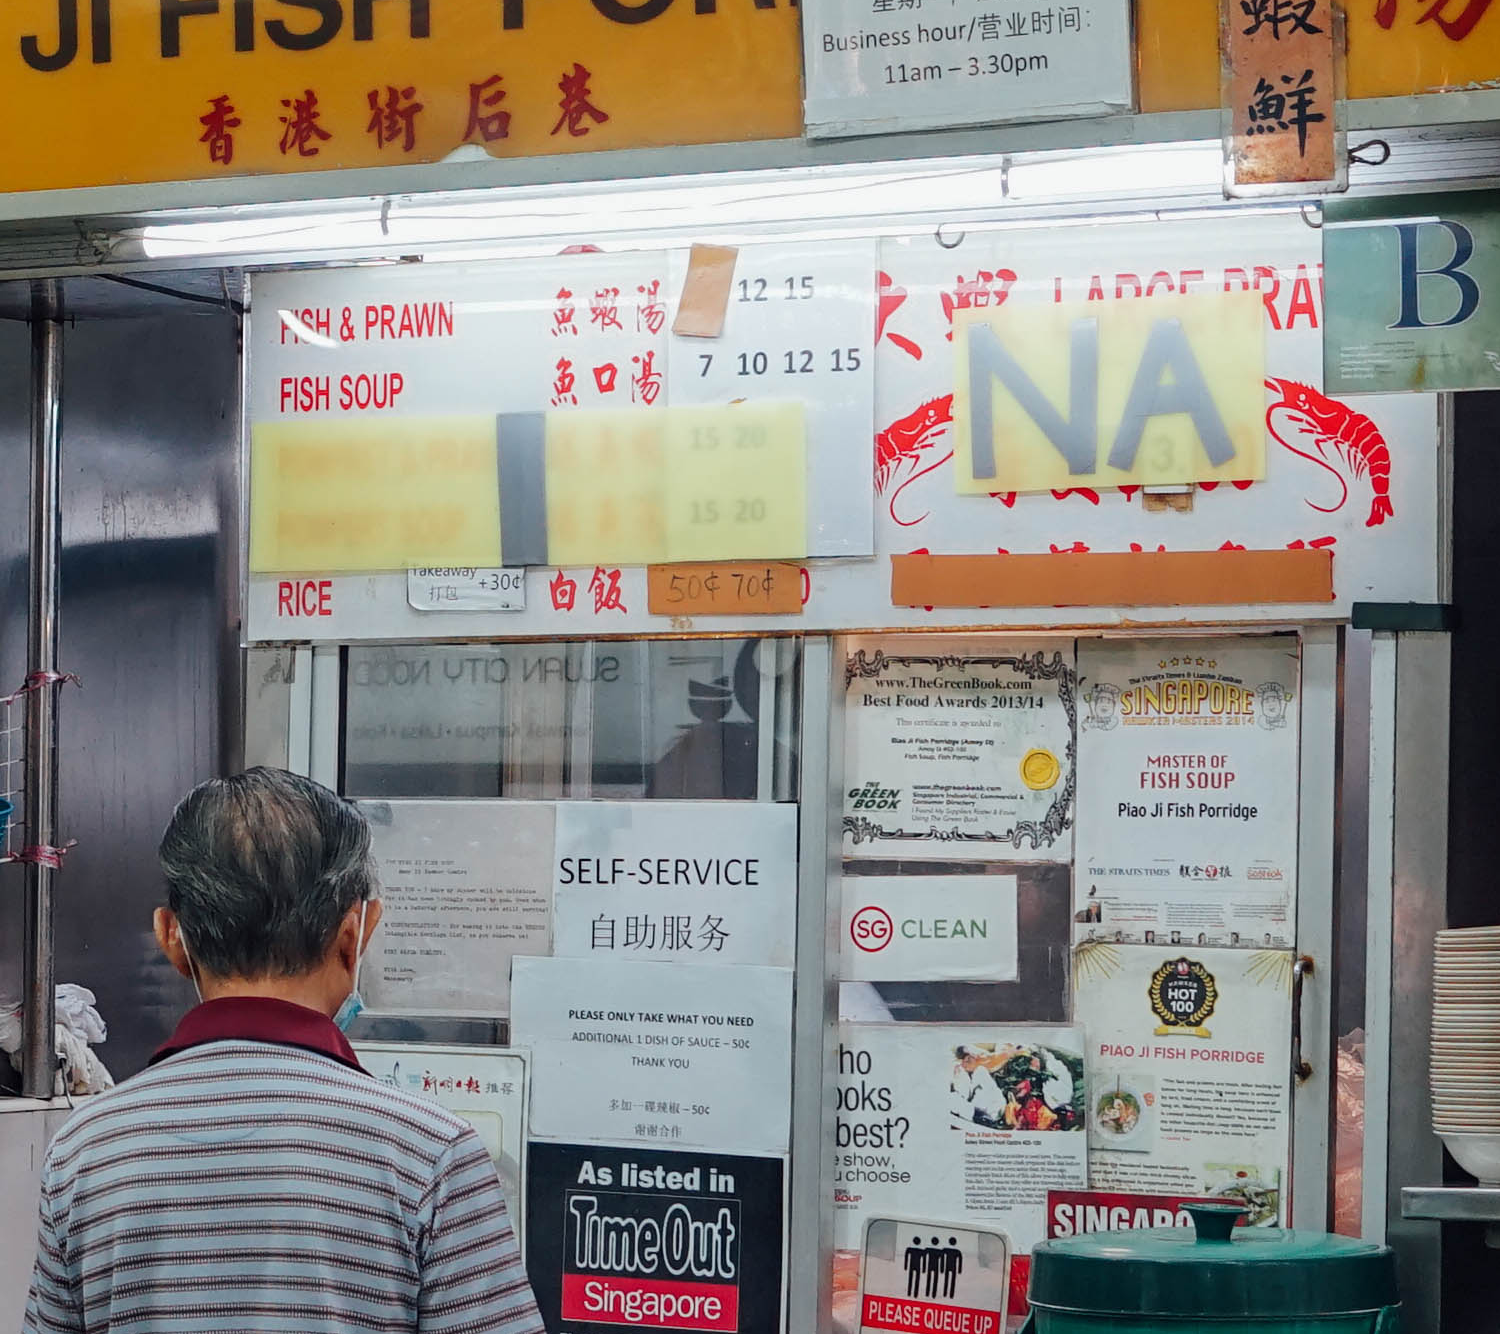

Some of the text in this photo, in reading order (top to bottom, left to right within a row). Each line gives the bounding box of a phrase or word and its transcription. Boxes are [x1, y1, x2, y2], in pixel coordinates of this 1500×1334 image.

[823, 23, 912, 53] Business
[884, 52, 1049, 85] 11am 3.30pm
[197, 65, 612, 166] 香港街后巷
[737, 275, 815, 303] 12 15
[1385, 220, 1481, 331] B
[280, 301, 454, 345] FISH & PRAWN
[551, 279, 667, 337] 魚蝦湯
[699, 347, 861, 378] 7 10 12 15
[280, 372, 404, 413] FISH SOUP
[967, 316, 1237, 480] NA
[277, 580, 333, 618] RICE
[548, 564, 629, 615] 白飯
[875, 677, 1033, 690] www.TheGreenBook.com
[1119, 679, 1256, 716] SINGAPORE
[863, 694, 1044, 710] Best Food Awards 2013/14
[1147, 755, 1229, 769] MASTER OF
[848, 788, 901, 799] GREEN
[1140, 772, 1236, 790] FISH SOUP
[853, 799, 901, 810] BOOK
[1118, 802, 1259, 821] Piao Ji Fish Porridge
[559, 857, 760, 886] SELF-SERVICE
[591, 912, 731, 953] 自助服务
[856, 919, 988, 939] SG CLEAN
[1167, 988, 1198, 1001] HOT
[1170, 1001, 1195, 1013] 100
[568, 1009, 755, 1027] PLEASE ONLY TAKE WHAT YOU NEED
[571, 1031, 634, 1045] ADDITIONAL
[636, 1034, 642, 1045] 1
[645, 1034, 669, 1045] DISH
[671, 1035, 686, 1046] OF
[688, 1037, 721, 1048] SAUCE
[1100, 1044, 1265, 1065] PIAO JI FISH PORRIDGE
[631, 1056, 690, 1069] THANK YOU
[839, 1043, 872, 1076] ho
[835, 1117, 911, 1149] best?
[843, 1151, 895, 1170] show,
[845, 1168, 911, 1183] choose
[576, 1161, 735, 1193] As listed in
[569, 1195, 736, 1279] Time Out
[583, 1280, 722, 1323] Singapore
[868, 1300, 922, 1328] PLEASE
[923, 1308, 971, 1334] QUEUE
